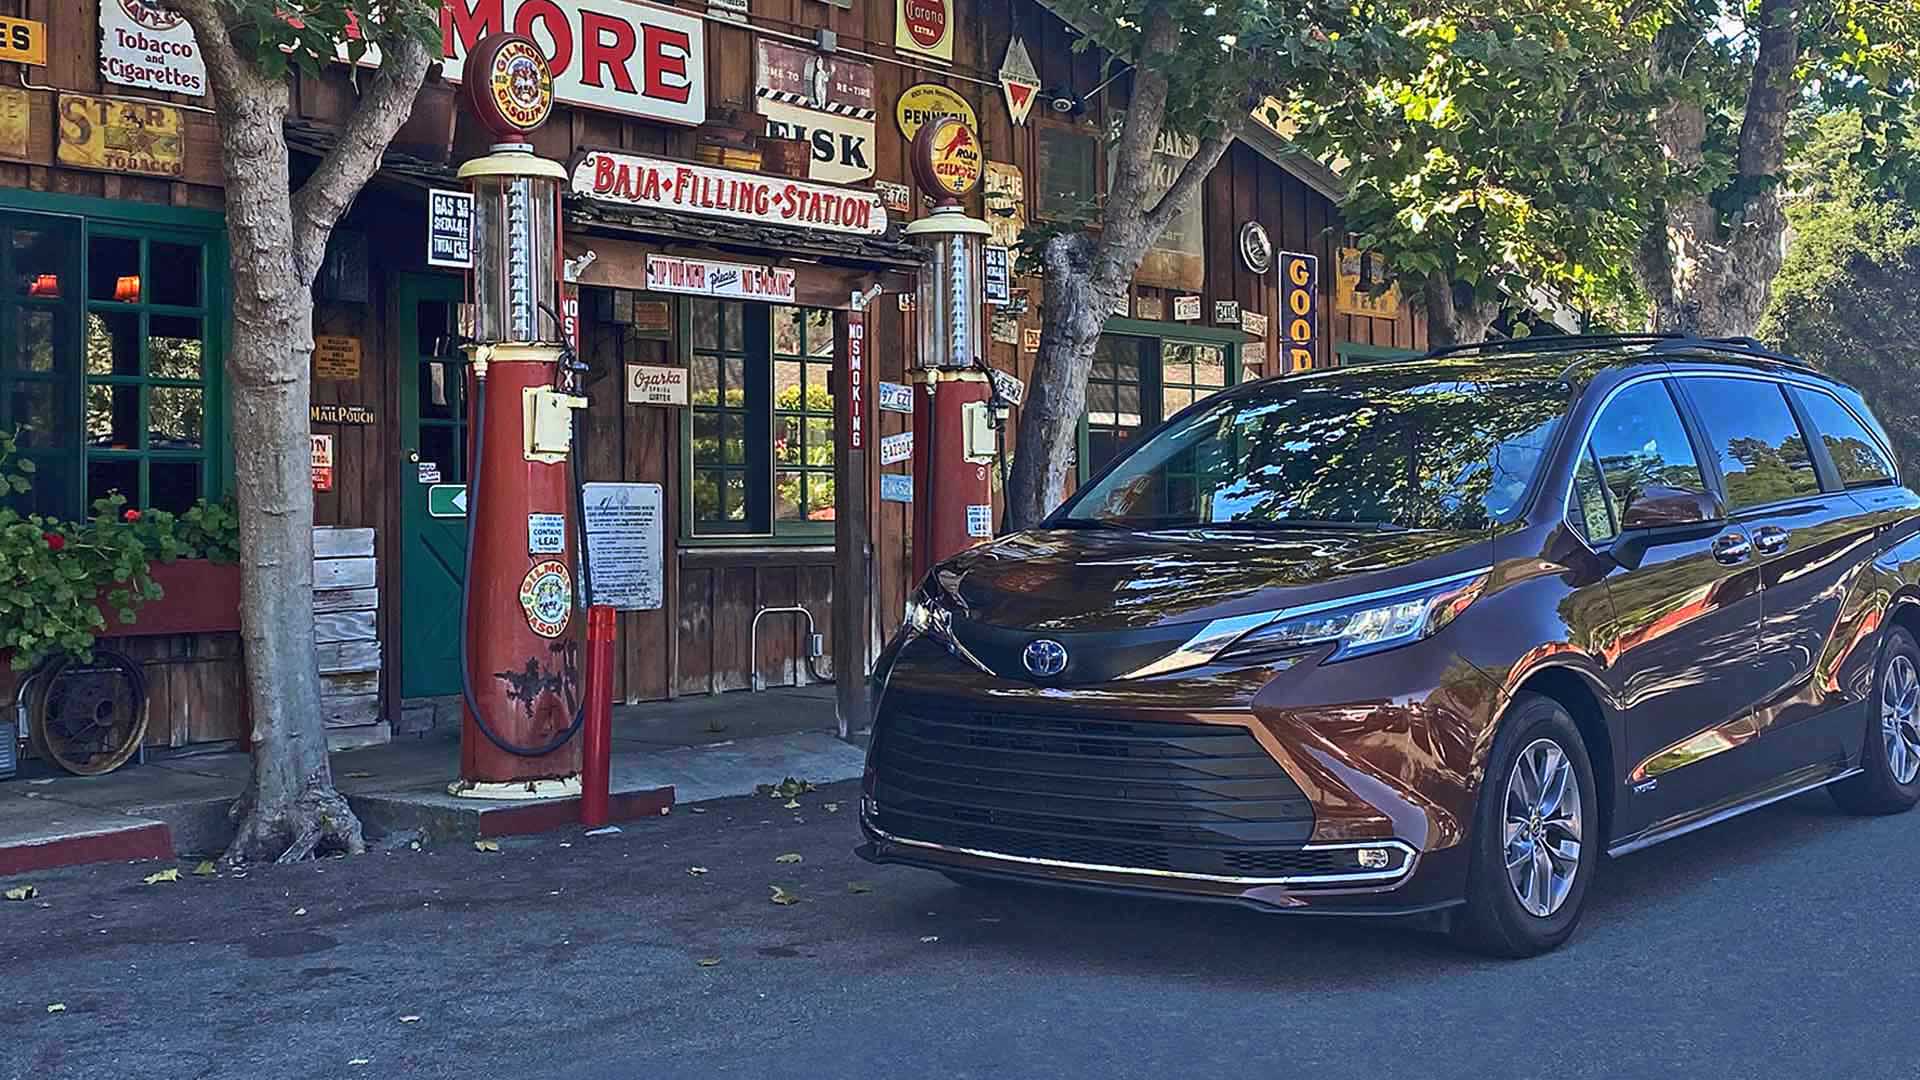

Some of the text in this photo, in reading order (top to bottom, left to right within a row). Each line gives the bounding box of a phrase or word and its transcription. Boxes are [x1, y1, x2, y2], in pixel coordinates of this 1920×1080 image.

[906, 0, 944, 25] Corona
[115, 28, 193, 58] Tobacco
[145, 53, 165, 65] and
[108, 57, 201, 89] Cigarettes
[594, 155, 873, 230] BAJA FILLING STATION
[742, 269, 753, 294] NO
[634, 368, 681, 392] Ozarka
[849, 324, 864, 447] NO SMOKING
[311, 406, 374, 423] MAIL POUCH
[538, 536, 559, 546] LEAD
